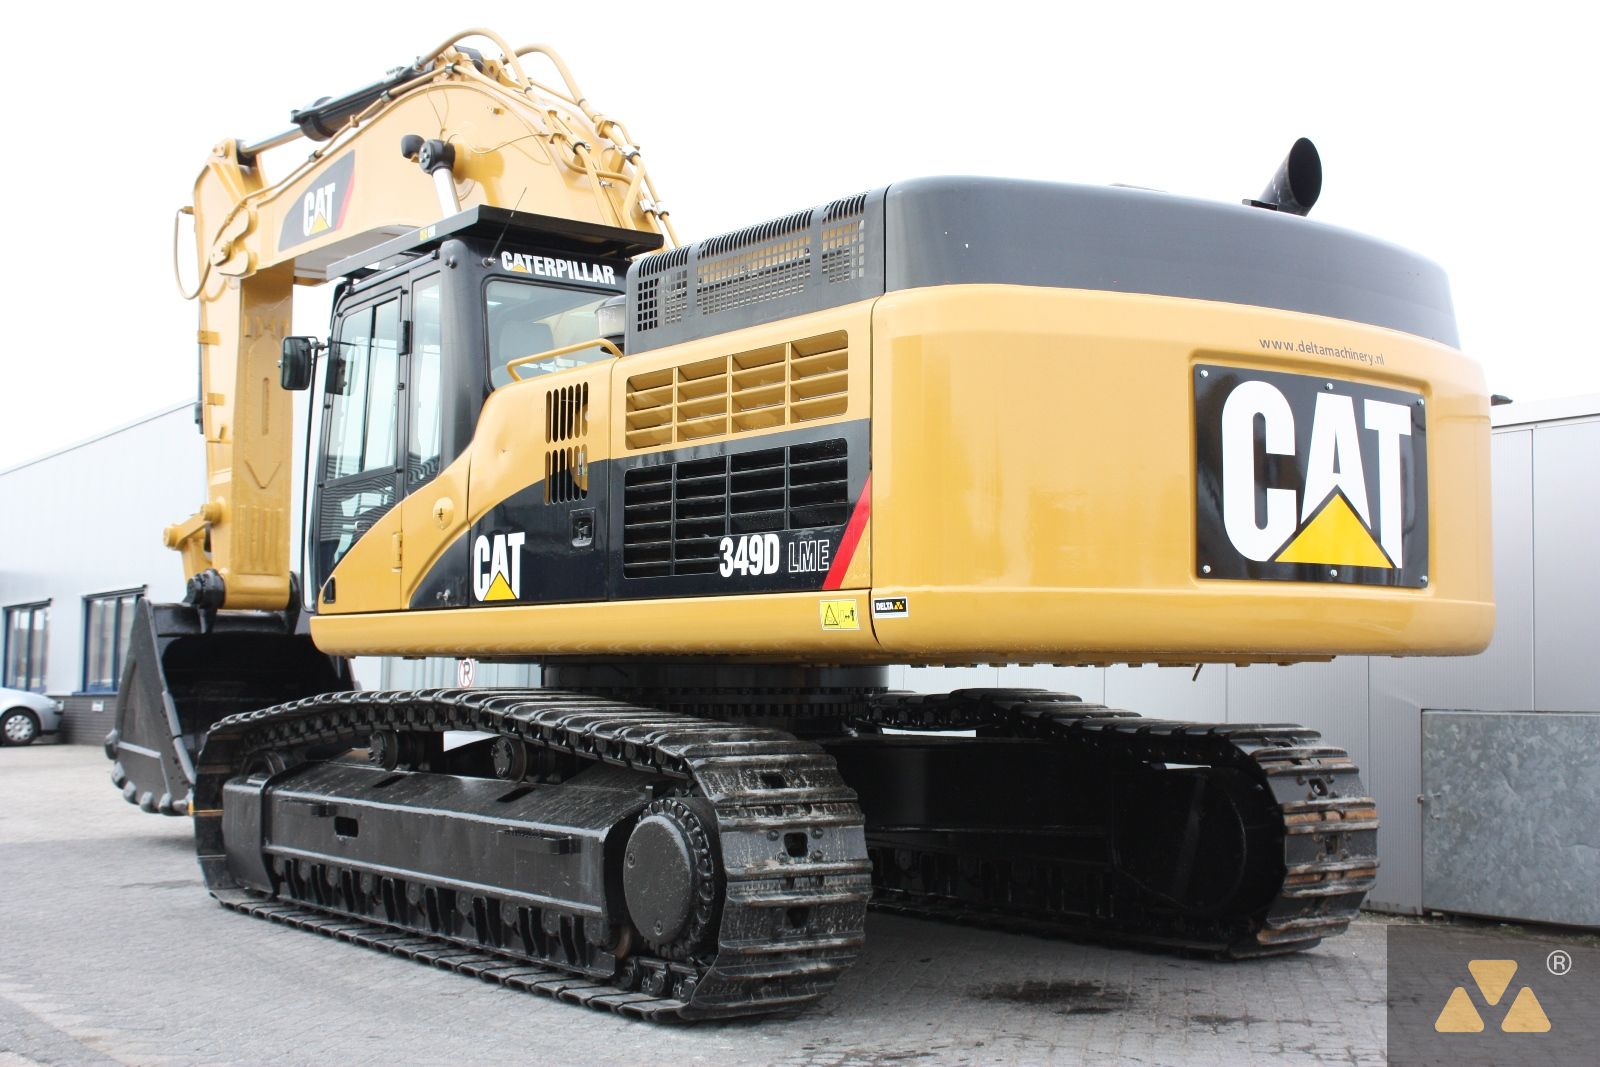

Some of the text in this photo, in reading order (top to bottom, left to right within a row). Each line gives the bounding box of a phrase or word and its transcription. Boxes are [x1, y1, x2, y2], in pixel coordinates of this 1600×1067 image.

[303, 182, 336, 237] CAT
[501, 251, 616, 285] CATERPILLAR
[1259, 338, 1385, 366] www.deltamachinery.nl
[1221, 380, 1412, 569] CAT
[473, 531, 526, 602] CAT
[719, 533, 830, 578] 349D LME
[875, 601, 893, 611] DELTA
